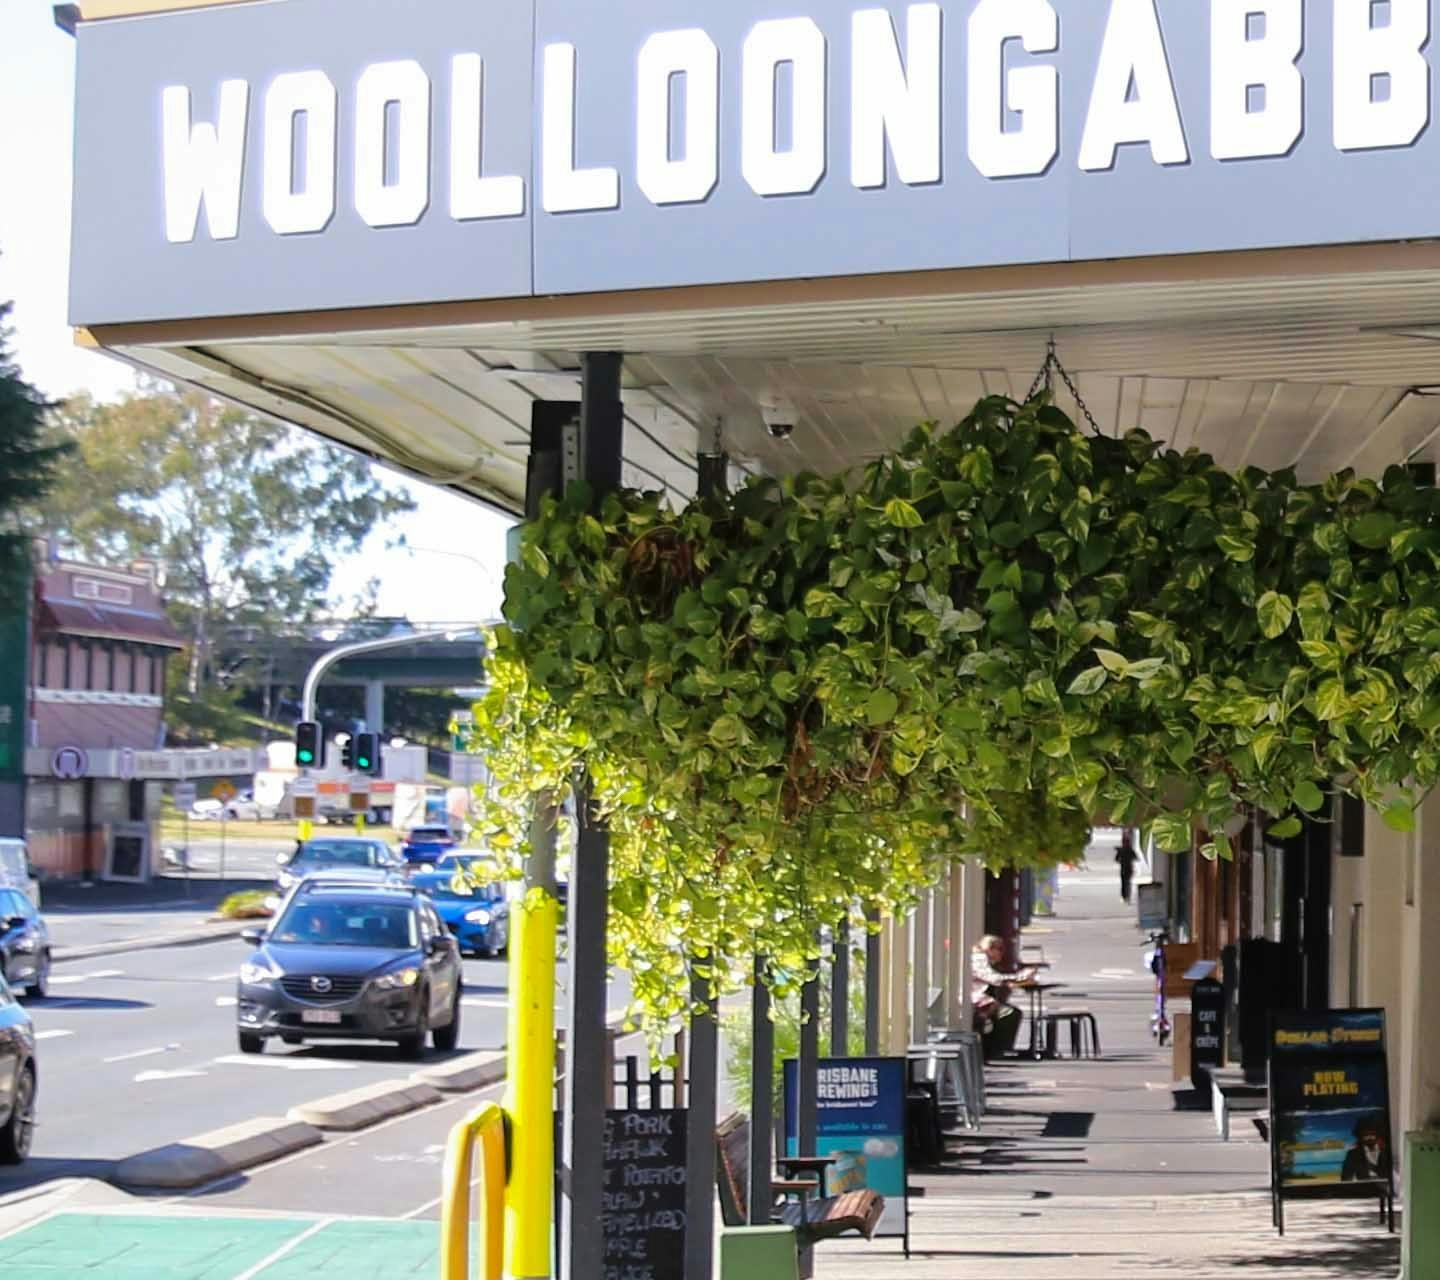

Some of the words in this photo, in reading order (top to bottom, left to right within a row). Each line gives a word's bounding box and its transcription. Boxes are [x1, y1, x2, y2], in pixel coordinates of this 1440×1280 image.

[817, 1068, 878, 1083] RISBANE
[1314, 1071, 1346, 1083] NOW
[817, 1083, 870, 1099] REWING
[1303, 1082, 1359, 1097] PLAYING
